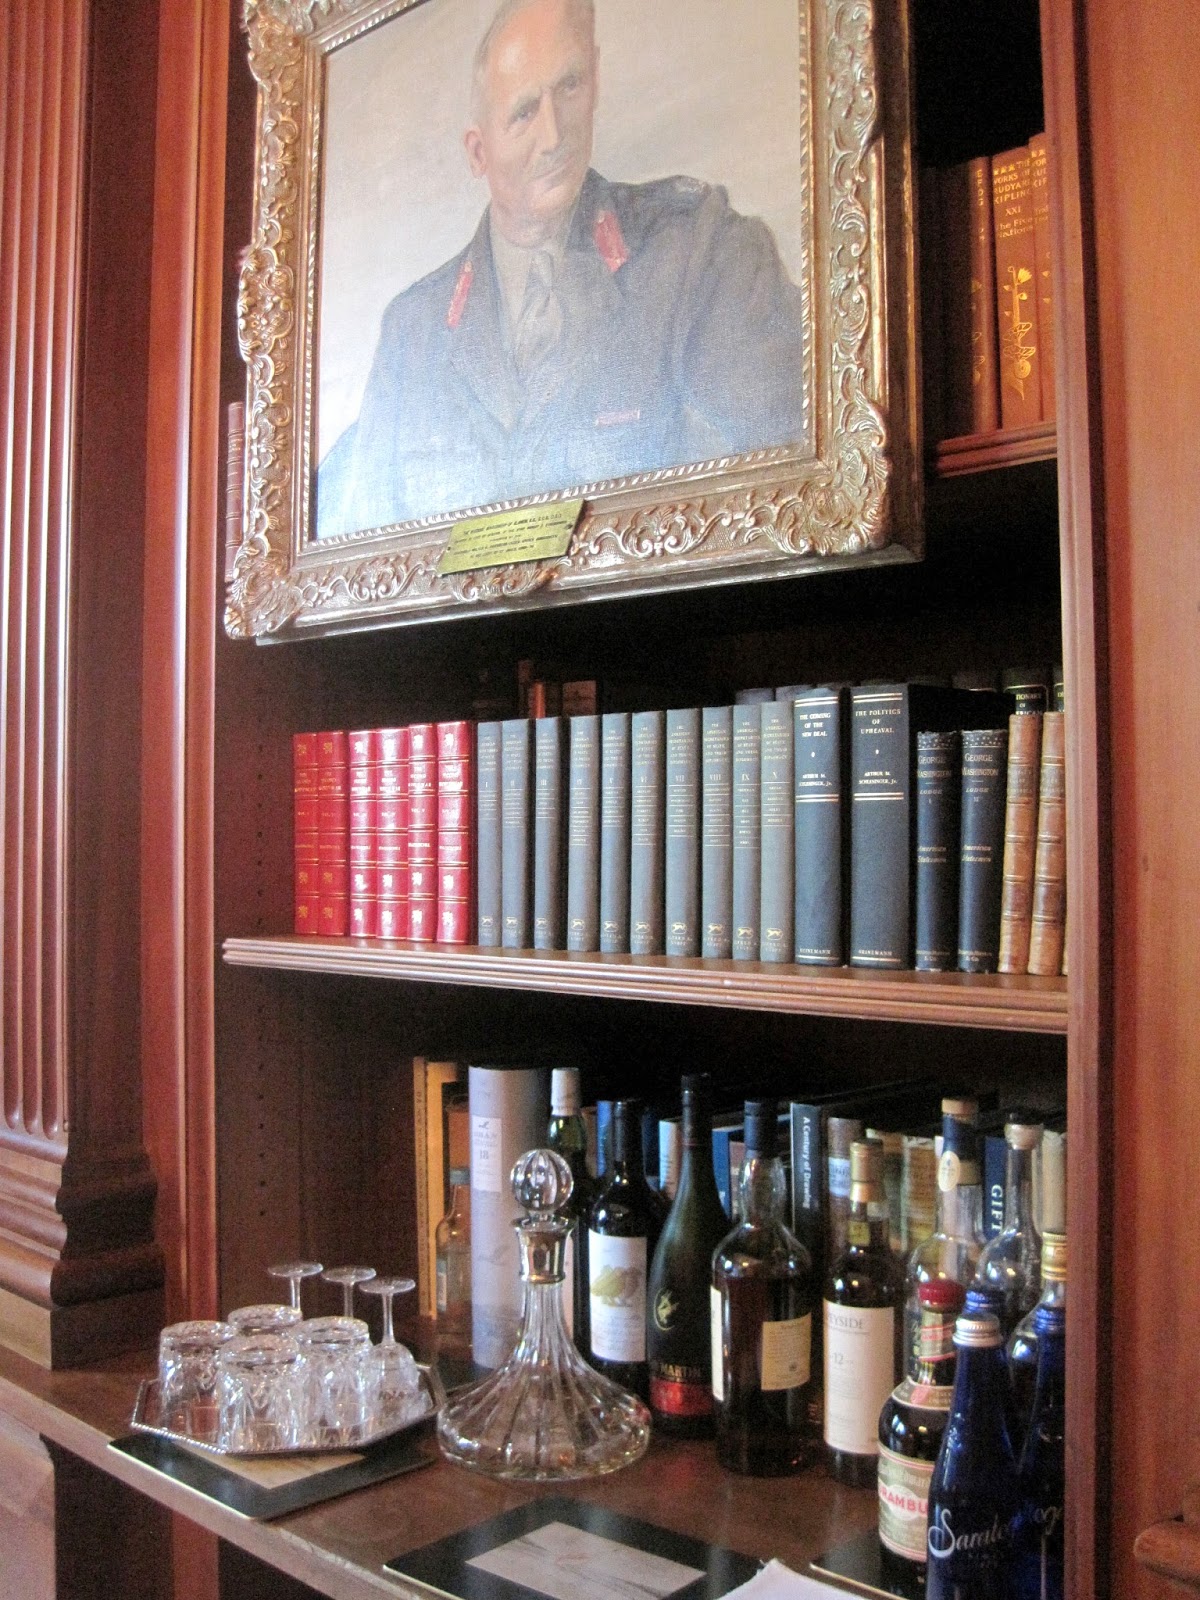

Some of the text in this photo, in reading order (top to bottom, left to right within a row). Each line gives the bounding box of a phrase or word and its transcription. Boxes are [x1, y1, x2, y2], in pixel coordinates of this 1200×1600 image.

[809, 712, 832, 720] COMING
[869, 708, 901, 716] POLITICS
[860, 727, 895, 735] UPHEAVAL
[964, 752, 994, 762] GEORGE
[961, 766, 999, 777] WASHINGTON
[801, 1116, 811, 1210] A Century of Drawing
[991, 1184, 1003, 1230] GIFT
